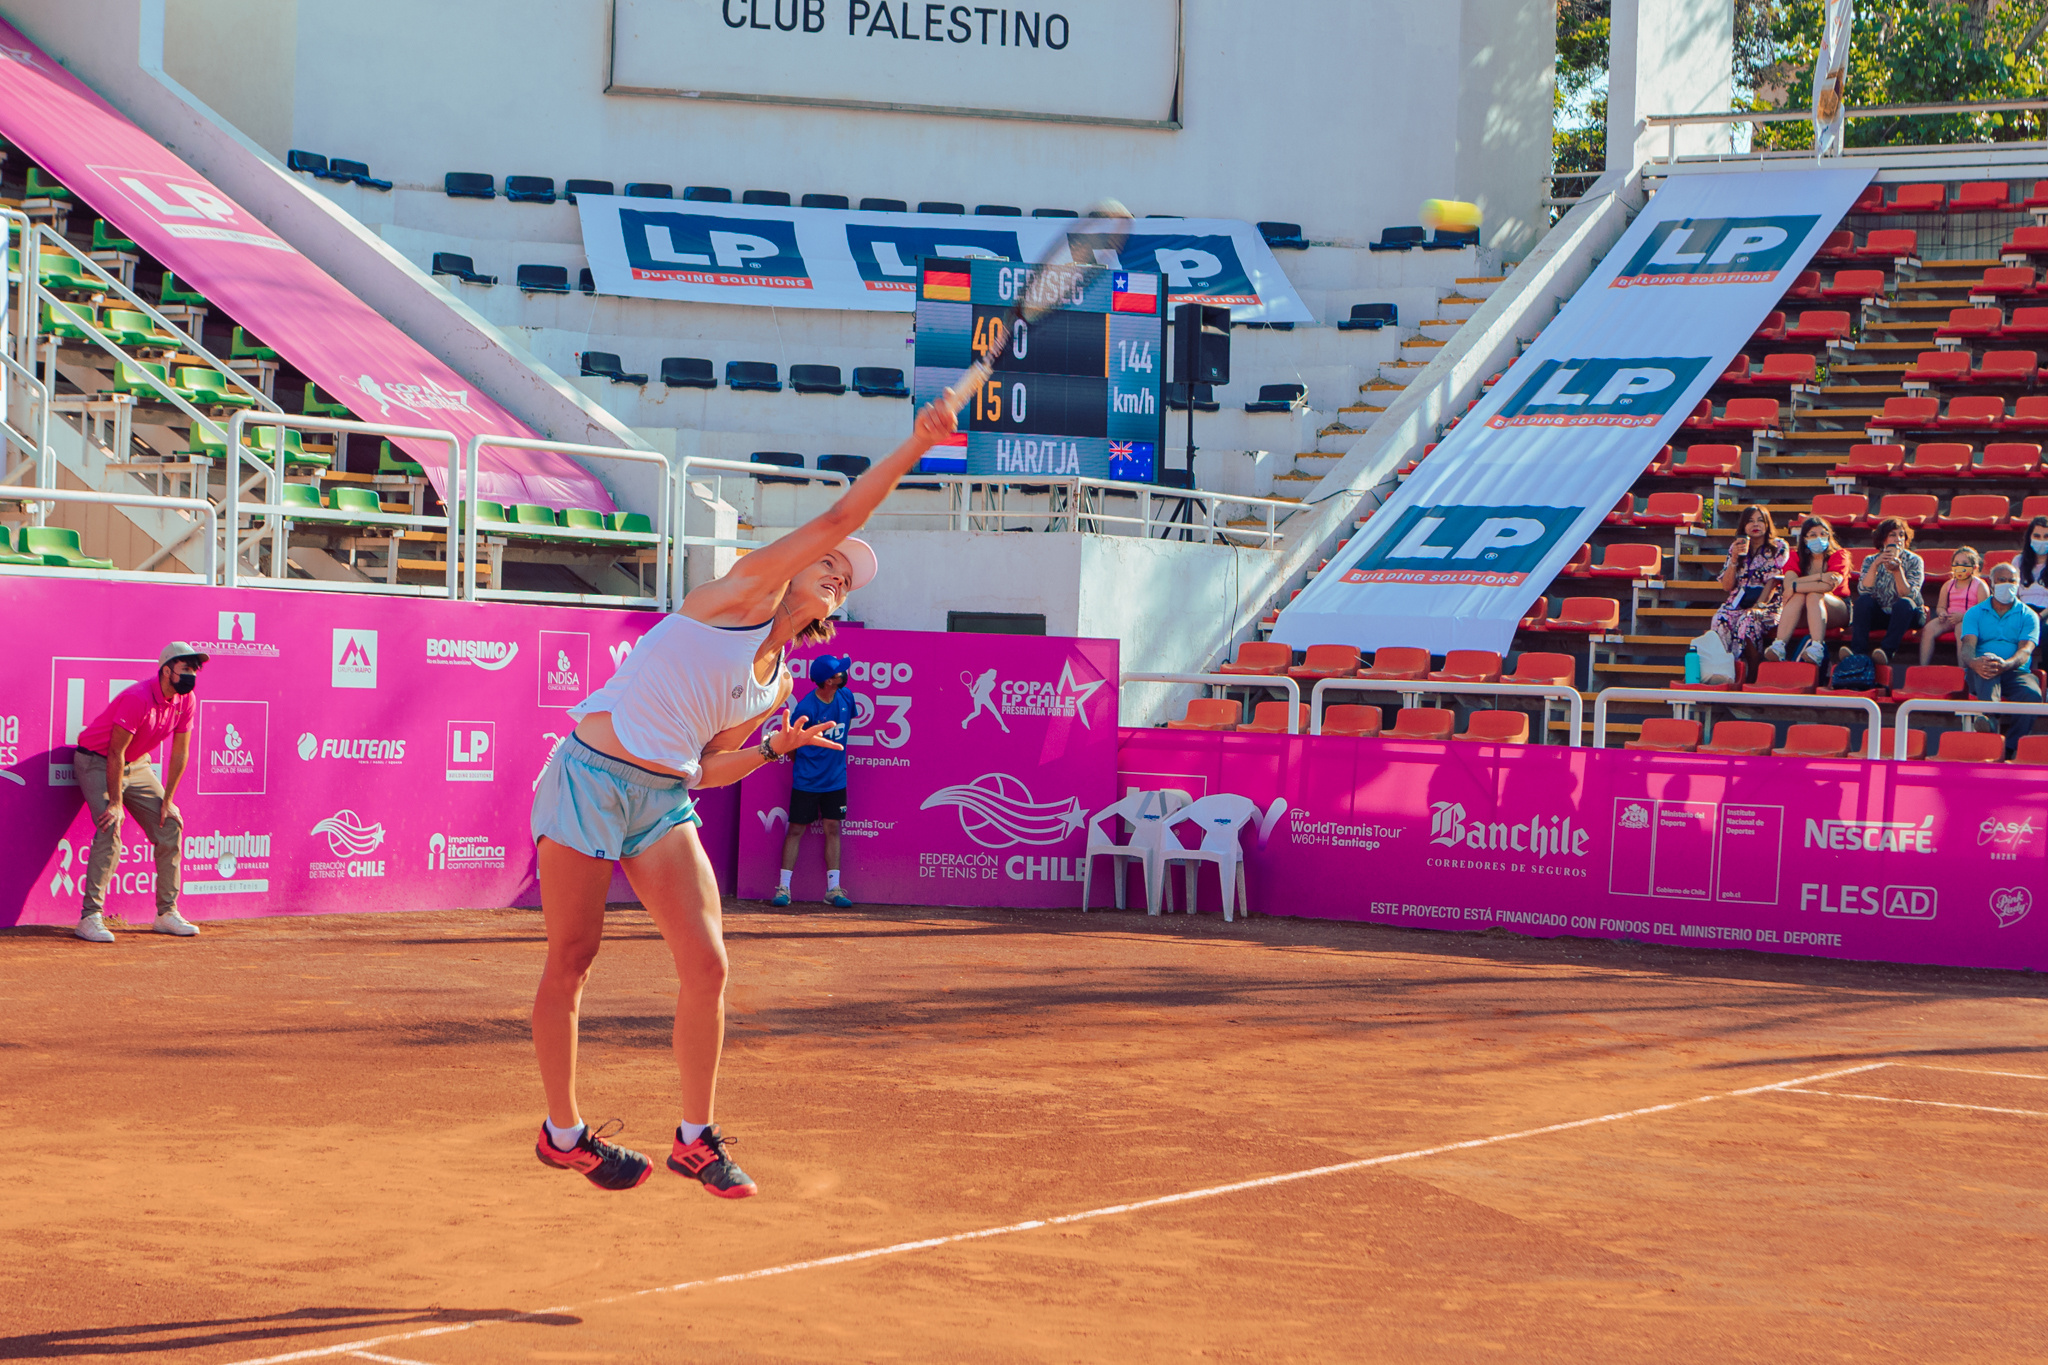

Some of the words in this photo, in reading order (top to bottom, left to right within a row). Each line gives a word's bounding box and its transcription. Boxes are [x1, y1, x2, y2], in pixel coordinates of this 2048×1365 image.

[722, 0, 825, 33] CLUB
[849, 0, 1069, 50] PALESTINO
[118, 176, 234, 223] LP
[644, 224, 779, 268] LP
[1648, 226, 1788, 264] LP
[641, 270, 715, 284] BUILDING
[720, 275, 806, 288] SOLUTIONS
[874, 282, 917, 291] BUILD
[1618, 273, 1683, 287] BUILDING
[1690, 272, 1770, 285] SOLUTIONS
[1174, 294, 1256, 304] SOLUTIONS
[972, 316, 1003, 358] 40
[1013, 318, 1028, 360] 0
[1118, 340, 1153, 374] 144
[1527, 368, 1676, 407] LP
[976, 380, 1002, 422] 15
[1011, 382, 1027, 423] 0
[1113, 386, 1155, 415] km/h
[1493, 415, 1565, 428] BUILDING
[1570, 415, 1653, 427] SOLUTIONS
[997, 439, 1080, 475] HAR/TJA
[1386, 516, 1545, 560] LP
[1350, 571, 1423, 584] BUILDING
[1429, 572, 1518, 585] SOLUTIONS
[189, 641, 278, 651] CONTRACTAL
[547, 671, 580, 685] INDISA
[1001, 680, 1056, 695] COPA
[1002, 694, 1022, 706] LP
[1025, 695, 1075, 708] CHILE
[1002, 706, 1046, 716] PRESENTADA
[1048, 707, 1061, 716] POR
[1063, 708, 1075, 717] IND
[321, 739, 406, 759] FULLTENIS
[453, 730, 489, 762] LP
[211, 750, 254, 765] INDISA
[848, 755, 910, 767] ParapanAm
[1661, 810, 1693, 818] Ministerio
[1727, 809, 1755, 817] Instituto
[1660, 819, 1686, 828] Deporte
[1726, 818, 1755, 826] Nacional
[1980, 821, 2034, 834] CASA
[841, 827, 879, 838] Santiago
[1429, 801, 1590, 859] Banchile
[1726, 827, 1755, 835] Deportes
[184, 830, 271, 859] cachantun
[448, 835, 489, 844] imprenta
[1291, 833, 1329, 845] W60+H
[1331, 836, 1380, 851] Santiago
[448, 844, 505, 857] italiana
[1990, 852, 2017, 860] BAZAR
[193, 863, 212, 871] SABOR
[234, 862, 269, 870] NATURALEZA
[447, 861, 482, 869] cannoni
[920, 852, 998, 866] FEDERACIÓN
[319, 870, 336, 878] TENIS
[337, 870, 345, 878] DE
[347, 861, 385, 877] CHILE
[920, 867, 935, 878] DE
[940, 867, 977, 878] TENIS
[982, 868, 998, 879] DE
[1005, 855, 1087, 881] CHILE
[1427, 857, 1506, 872] CORREDORES
[1511, 863, 1526, 872] DE
[1531, 864, 1587, 877] SEGUROS
[78, 871, 158, 895] cncer
[194, 884, 226, 892] Refresca
[1656, 886, 1682, 894] Gobierno
[1691, 888, 1706, 896] Chile
[1722, 891, 1741, 899] gob.cl
[1800, 883, 1880, 915] FLES
[1888, 891, 1930, 914] AD
[1996, 891, 2024, 909] Pink
[2000, 902, 2026, 917] Lady
[1371, 902, 1399, 915] ESTE
[1401, 904, 1460, 919] PROYECTO
[1463, 906, 1493, 921] ESTÁ
[1496, 910, 1567, 927] FINANCIADO
[1571, 917, 1597, 930] CON
[1600, 918, 1650, 935] FONDOS
[1653, 921, 1677, 936] DEL
[1680, 924, 1753, 941] MINISTERIO
[1756, 929, 1780, 943] DEL
[1783, 931, 1842, 947] DEPORTE
